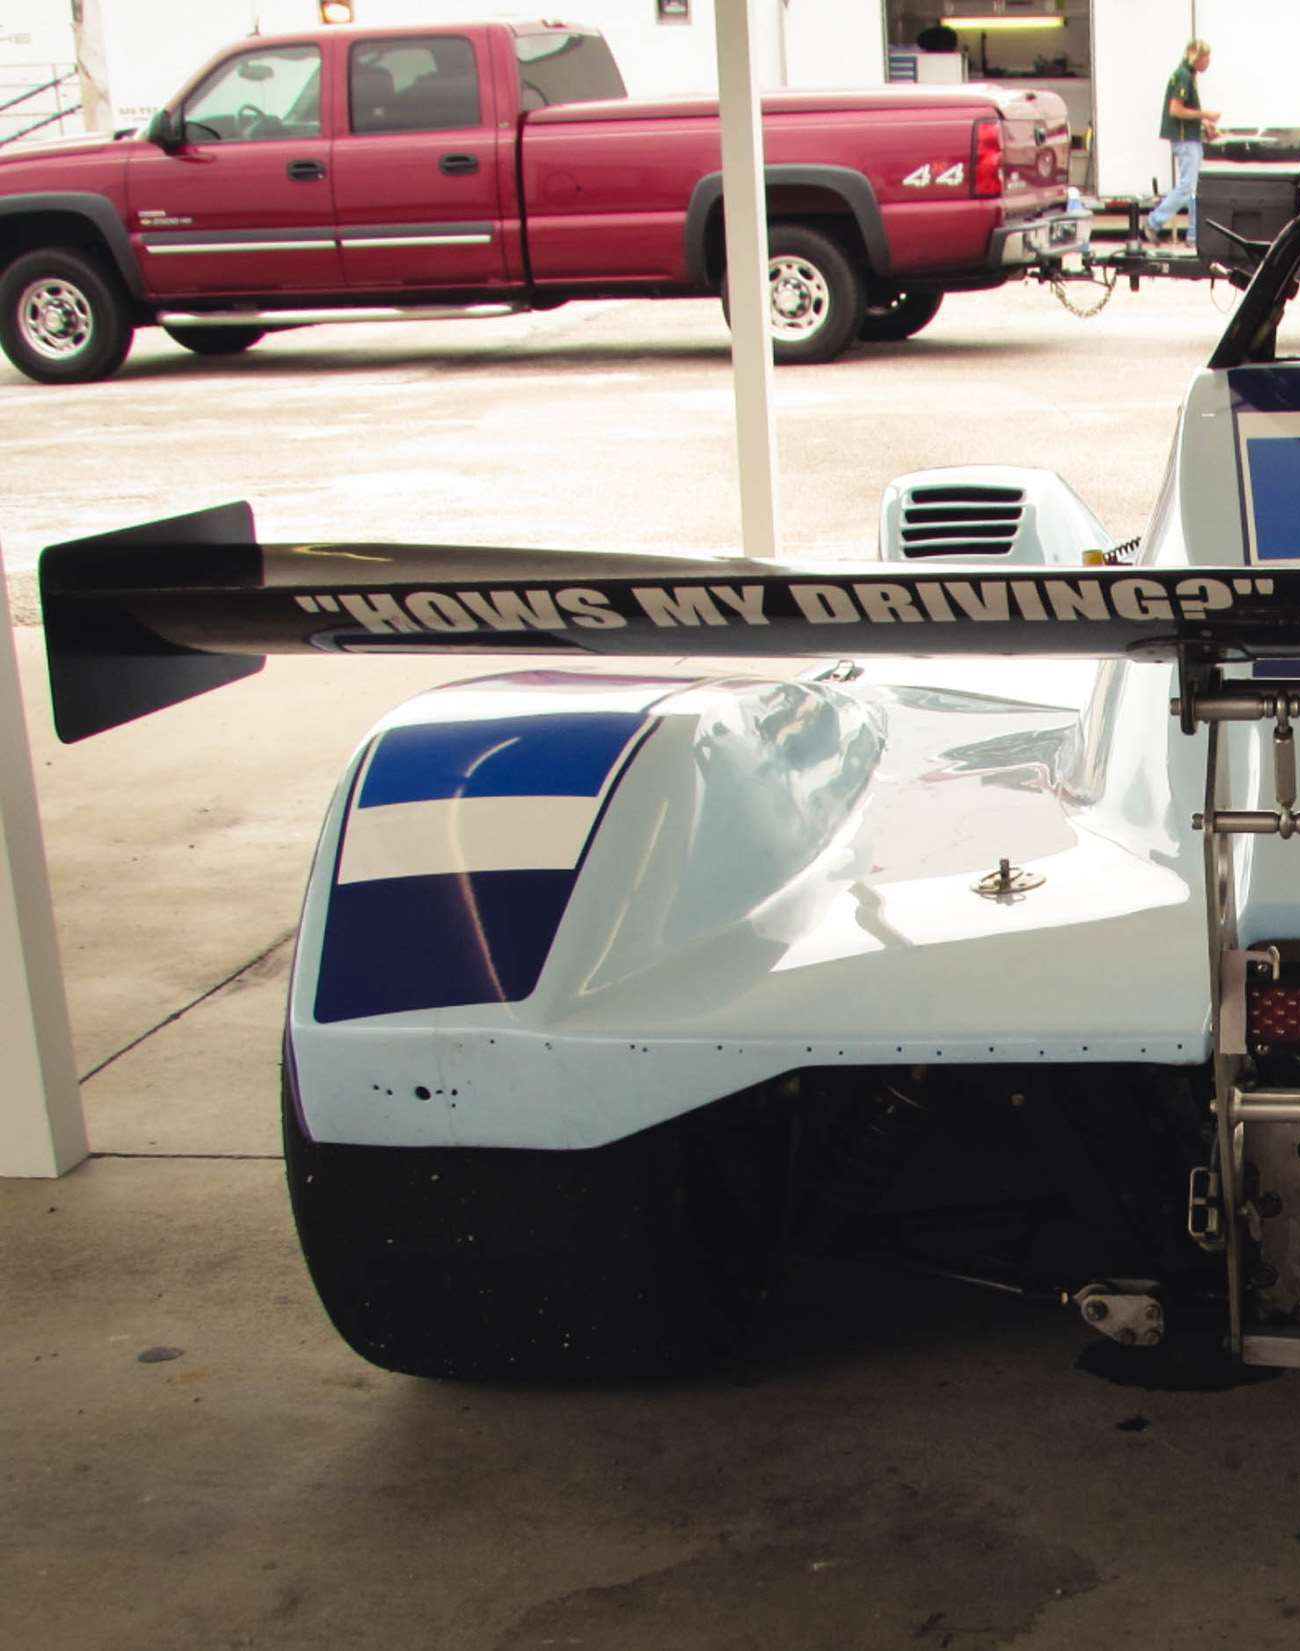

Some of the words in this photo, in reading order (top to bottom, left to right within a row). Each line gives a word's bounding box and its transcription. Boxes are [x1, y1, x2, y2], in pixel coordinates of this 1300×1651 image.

[295, 588, 627, 634] "HOWS
[631, 584, 770, 627] MY
[788, 577, 1273, 621] DRIVING?"
